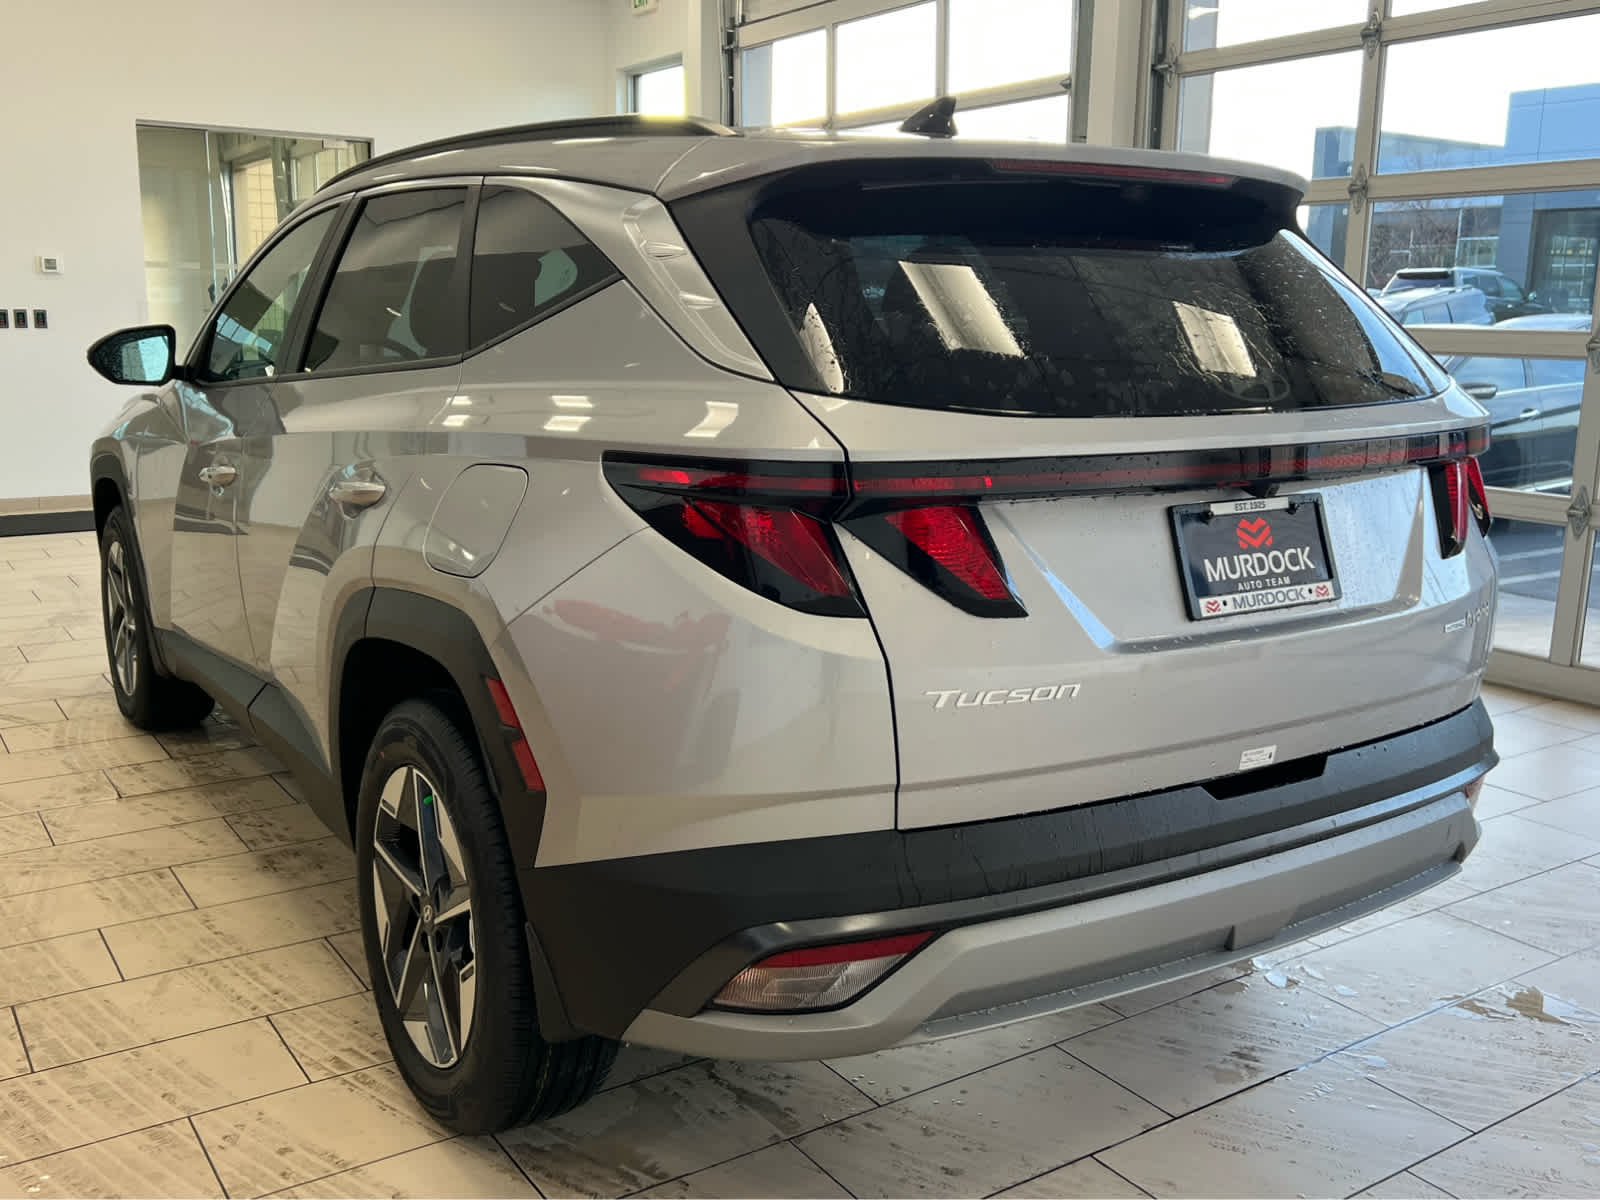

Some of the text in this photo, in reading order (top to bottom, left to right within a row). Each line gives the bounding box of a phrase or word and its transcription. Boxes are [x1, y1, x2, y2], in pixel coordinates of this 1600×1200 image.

[1234, 502, 1249, 511] EST.
[1203, 546, 1316, 582] MURDOCK
[1237, 576, 1291, 591] AUTO TEAM
[1232, 587, 1305, 610] MURDOCK
